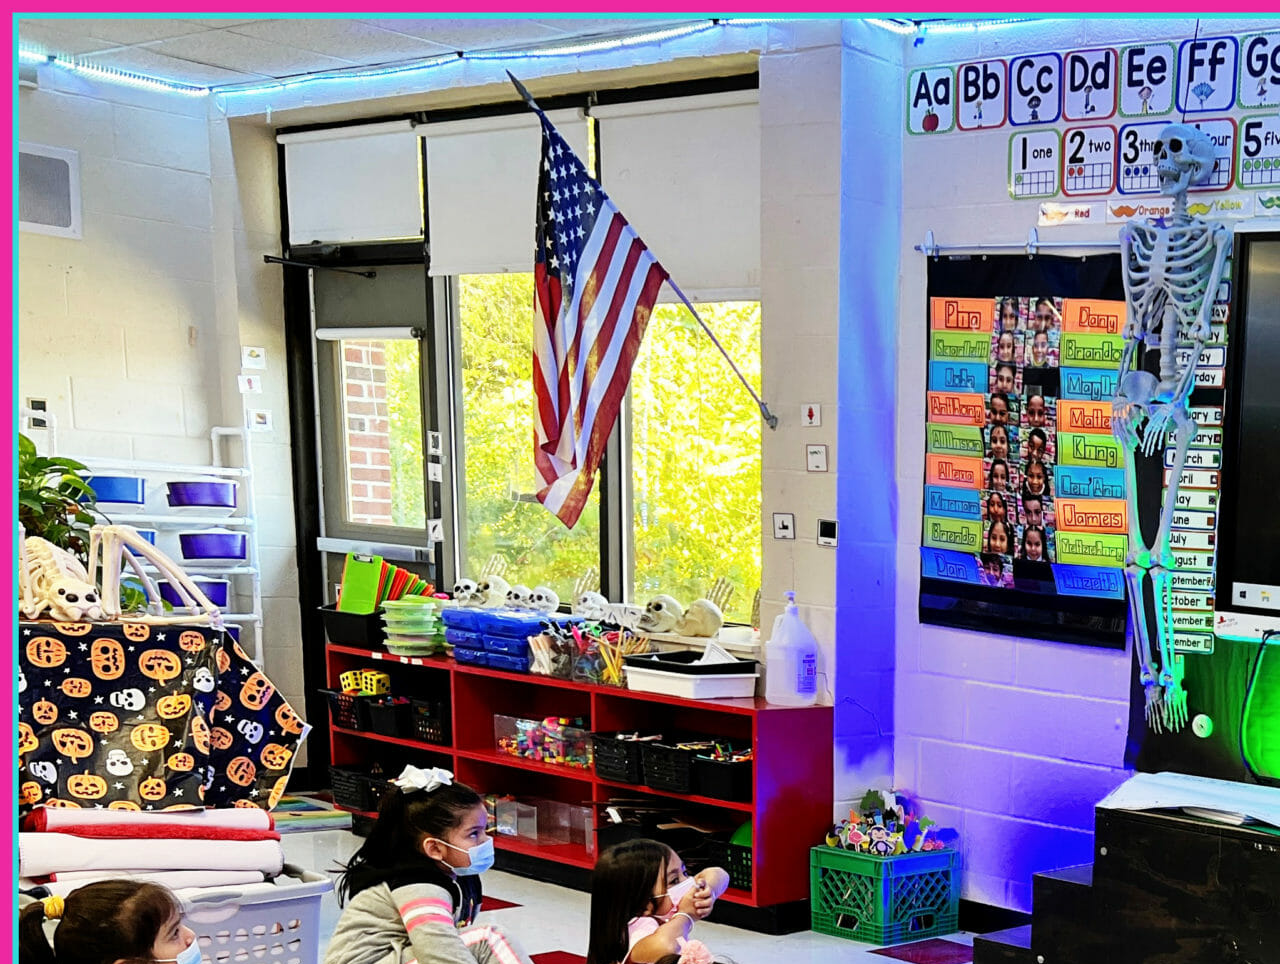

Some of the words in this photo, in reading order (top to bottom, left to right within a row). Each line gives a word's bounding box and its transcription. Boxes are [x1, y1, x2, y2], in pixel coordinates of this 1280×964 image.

[913, 72, 950, 108] Aa
[963, 64, 1000, 102] Bb
[1016, 60, 1053, 97] Cc
[1069, 51, 1111, 91] Dd
[1126, 48, 1167, 87] Ee
[1188, 42, 1227, 82] Ff
[1021, 137, 1027, 170] 1
[1032, 147, 1053, 160] one
[1068, 130, 1085, 163] 2
[1089, 140, 1111, 153] two
[1123, 130, 1139, 164] 3
[1244, 122, 1262, 157] 5
[1074, 208, 1090, 219] Red
[1138, 203, 1170, 217] Orange
[945, 300, 981, 329] Pia
[1079, 306, 1118, 334] Dany
[1073, 436, 1117, 467] King
[1063, 503, 1123, 528] James
[1169, 532, 1187, 546] July
